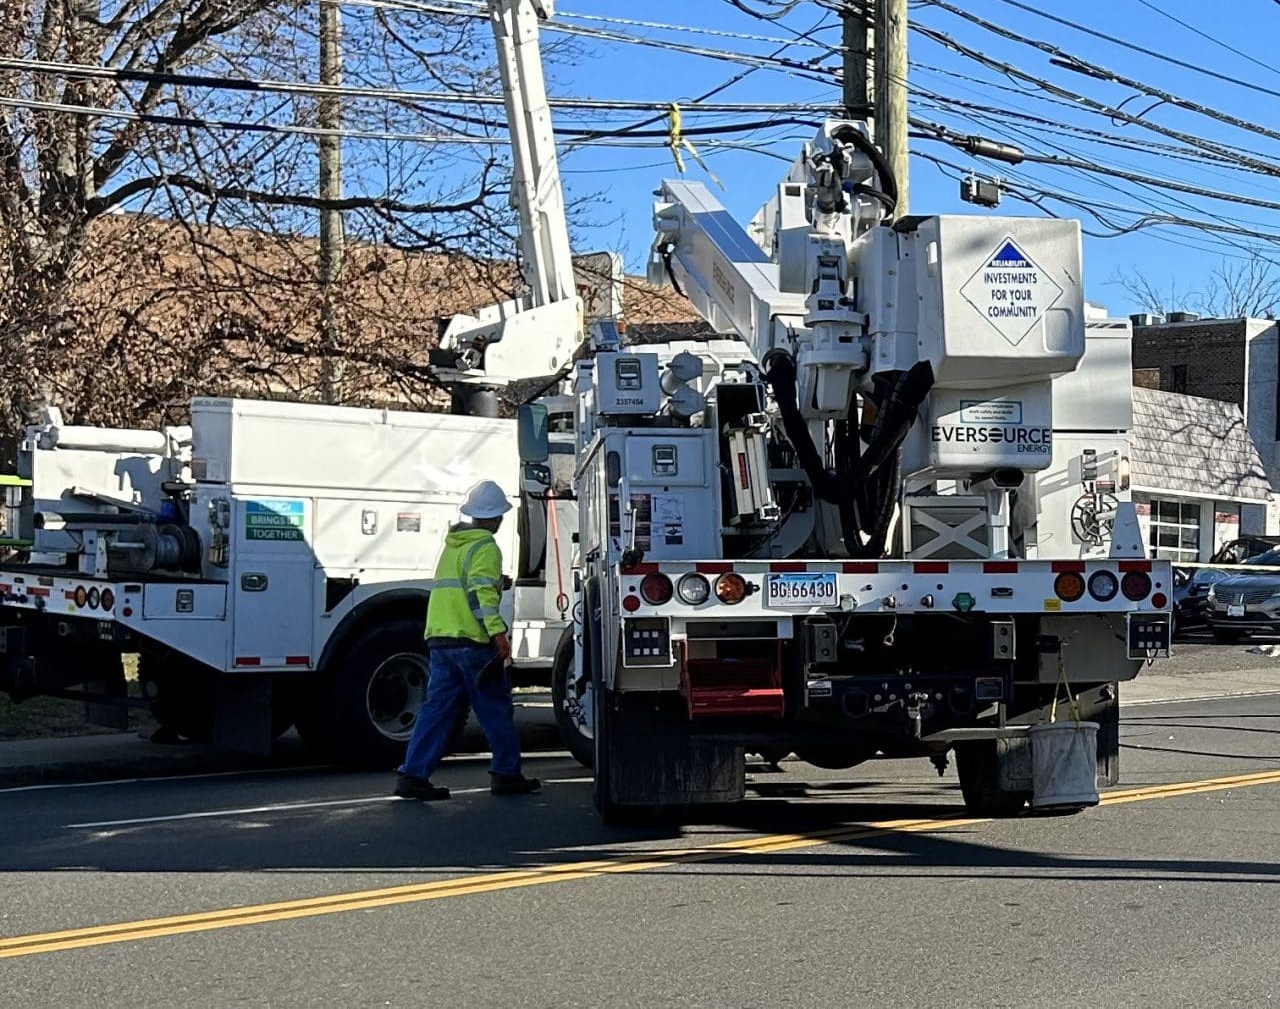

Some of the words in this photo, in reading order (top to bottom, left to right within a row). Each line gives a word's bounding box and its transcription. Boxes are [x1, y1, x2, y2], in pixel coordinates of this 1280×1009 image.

[984, 273, 1037, 284] INVESTMENTS
[991, 290, 1007, 301] FOR
[1009, 290, 1032, 301] YOUR
[987, 306, 1038, 318] COMMUNITY
[931, 427, 1051, 443] EVERSOURCE
[1017, 444, 1051, 453] ENERGY
[252, 516, 285, 525] BRINGS
[253, 530, 298, 539] TOGETHER
